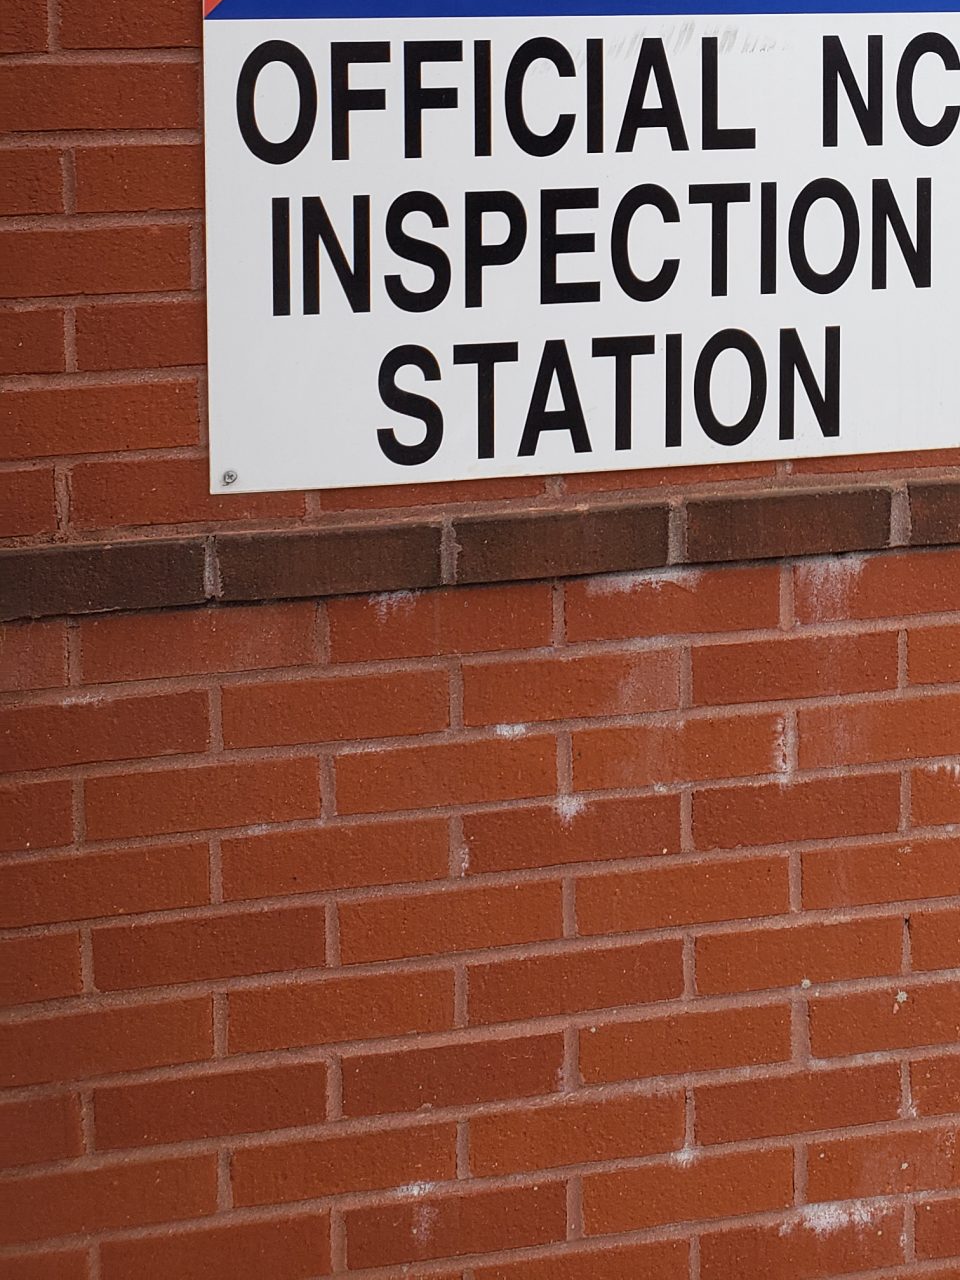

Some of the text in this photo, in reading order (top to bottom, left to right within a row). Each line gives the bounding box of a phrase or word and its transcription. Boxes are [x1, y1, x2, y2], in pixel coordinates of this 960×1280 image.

[236, 35, 757, 165] OFFICIAL
[271, 176, 933, 317] INSPECTION
[376, 324, 842, 467] STATION
